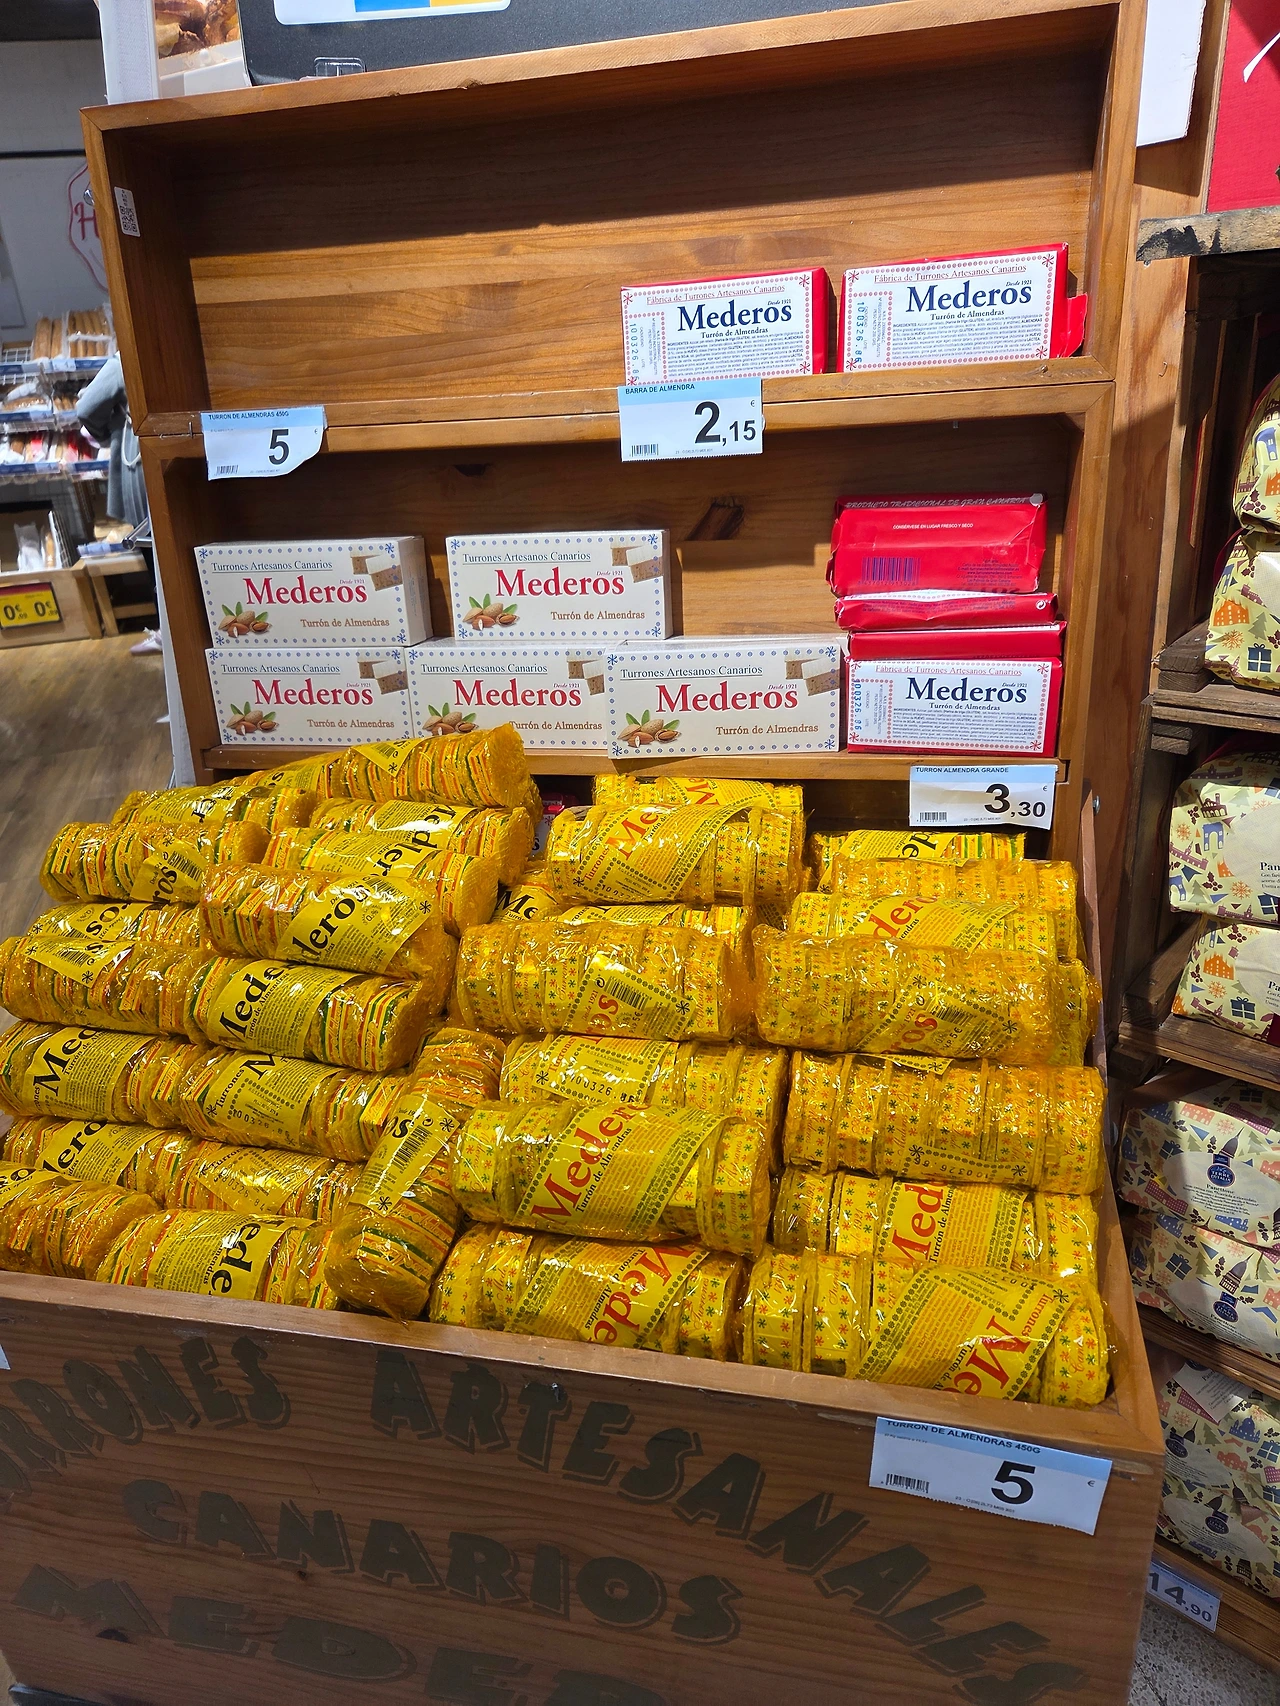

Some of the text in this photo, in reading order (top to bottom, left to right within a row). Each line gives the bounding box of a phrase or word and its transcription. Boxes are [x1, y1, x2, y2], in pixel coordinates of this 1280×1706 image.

[874, 263, 1027, 284] Fábrica de Turrones Artesanos Canarios
[646, 283, 786, 306] Fábrica de Turrones Artesanos Canarios
[905, 279, 1033, 313] Mederos
[677, 299, 792, 332] Mederos
[929, 308, 1005, 322] Turrón de Almendras
[701, 327, 769, 339] Turrón de Almendras
[625, 387, 648, 395] BARRA
[659, 383, 696, 392] ALMENDRA
[208, 413, 233, 421] TURRON
[233, 412, 240, 420] DE
[240, 411, 275, 419] ALMENDRAS
[268, 428, 290, 466] 5
[462, 550, 591, 564] Turrones Artesanos Canarios
[211, 559, 333, 572] Turrones Artesanos Canarios
[494, 566, 625, 597] Mederos
[243, 575, 369, 605] Mederos
[550, 609, 645, 621] Turrón de Almendras
[300, 617, 390, 629] Turrón de Almendras
[221, 663, 341, 674] Turrones Artesanos Canarios
[421, 662, 548, 674] Turrones Artesanos Canarios
[620, 664, 763, 679] Turrones Artesanos Canarios
[875, 665, 1023, 678] Fábrica de Turrones Artesanos Canarios
[252, 678, 374, 705] Mederos
[453, 677, 582, 707] Mederos
[655, 680, 799, 713] Mederos
[905, 677, 1028, 703] Mederos
[929, 702, 1001, 712] Turrón de Almendras
[307, 718, 395, 729] Turrón de Almendras
[509, 720, 602, 731] Turrón de Almendras
[715, 722, 819, 736] Turrón de Almendras
[915, 766, 1009, 774] TURRON ALMENDRA GRANDE
[215, 1069, 245, 1108] Turrones
[927, 1219, 949, 1264] Turrón de
[930, 1426, 946, 1435] DE
[947, 1428, 1013, 1449] ALMENDRAS
[1015, 1443, 1041, 1455] 450G
[990, 1459, 1036, 1505] 5
[122, 1478, 743, 1646] CANARIOS
